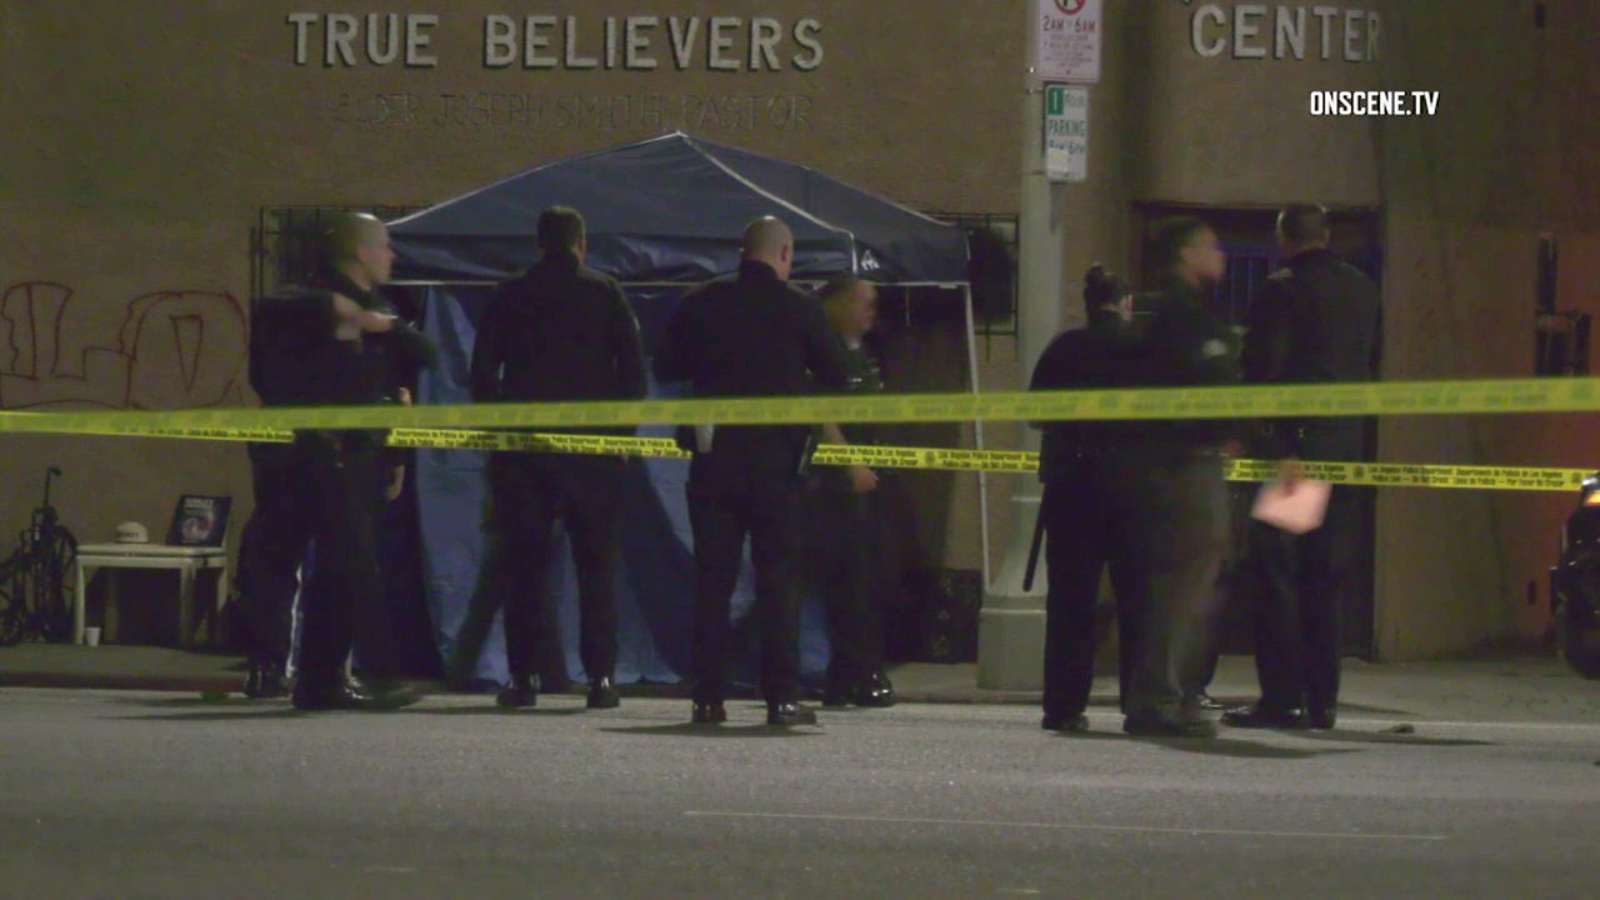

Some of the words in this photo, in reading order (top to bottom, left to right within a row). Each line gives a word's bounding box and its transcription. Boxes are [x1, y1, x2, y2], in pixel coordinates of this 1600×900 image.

[288, 13, 439, 67] TRUE
[482, 15, 824, 72] BELIEVERS
[1043, 15, 1064, 31] 2AM
[1075, 18, 1096, 32] 6AM
[1191, 6, 1381, 62] CENTER
[434, 92, 543, 127] JOSEPH
[555, 95, 662, 130] SMITH
[681, 93, 814, 131] PASTOR
[1049, 119, 1086, 137] PARKING
